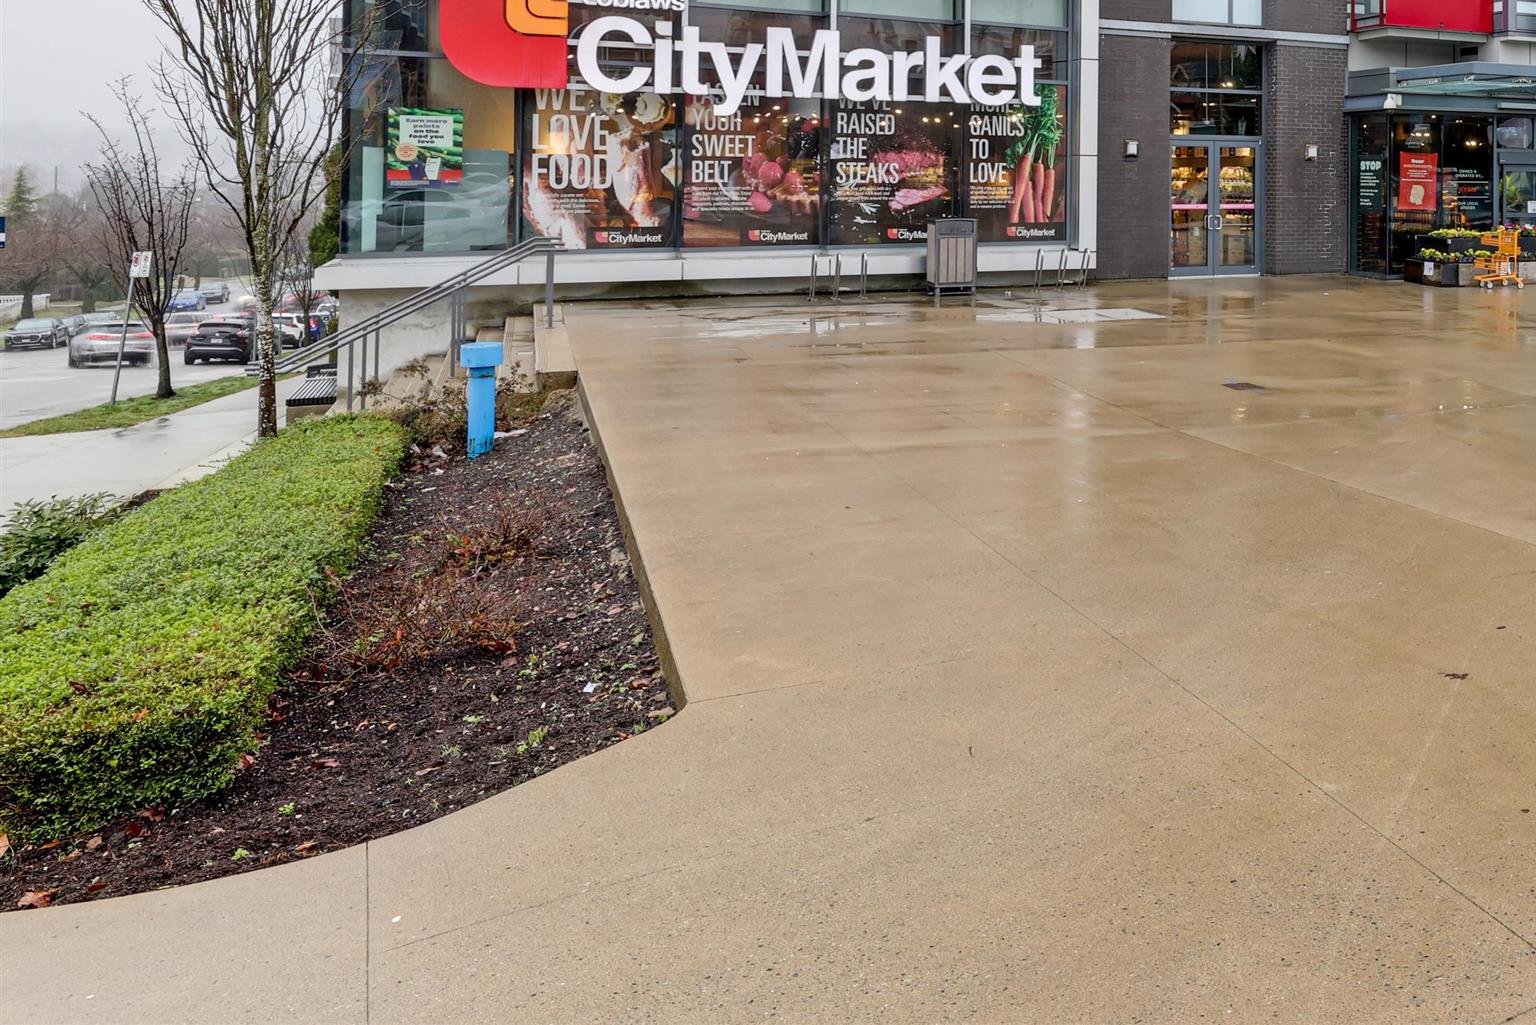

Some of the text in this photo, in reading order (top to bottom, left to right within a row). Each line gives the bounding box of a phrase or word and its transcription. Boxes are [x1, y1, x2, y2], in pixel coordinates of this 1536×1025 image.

[576, 15, 1042, 116] CityMarket
[535, 76, 586, 112] WE
[531, 113, 610, 150] LOVE
[837, 112, 896, 135] RAISED
[969, 115, 1025, 137] GANICS
[691, 134, 756, 158] SWEET
[836, 137, 868, 159] THE
[969, 138, 989, 160] TO
[531, 153, 612, 190] FOOD
[691, 160, 732, 183] BELT
[836, 162, 899, 184] STEAKS
[969, 162, 1007, 183] LOVE
[1360, 160, 1382, 171] STOP
[608, 233, 663, 244] CityMarket
[760, 231, 808, 243] CityMarket
[1016, 227, 1056, 239] CityMarket
